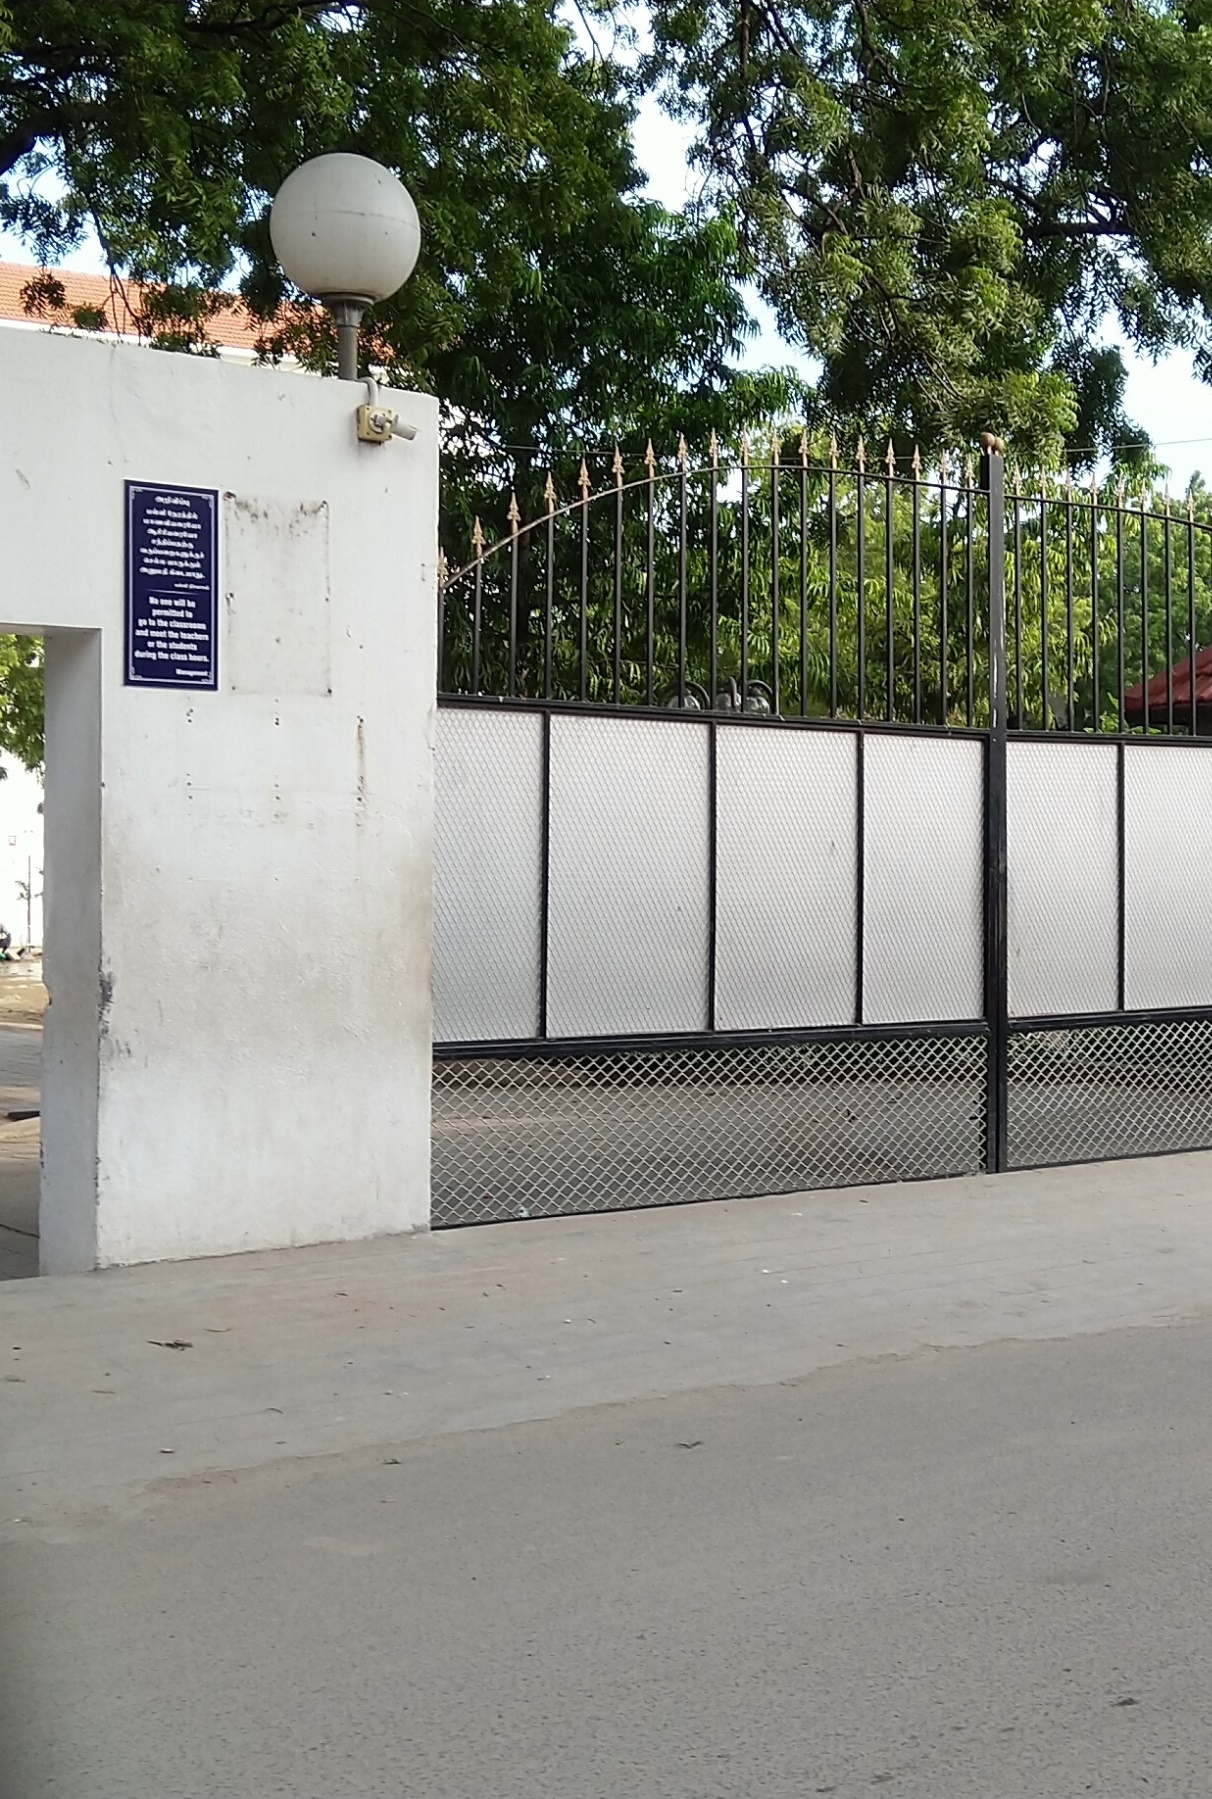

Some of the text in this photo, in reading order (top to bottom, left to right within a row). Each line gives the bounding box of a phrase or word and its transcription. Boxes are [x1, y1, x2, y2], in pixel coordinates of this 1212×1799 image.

[148, 596, 196, 608] No one will be
[152, 608, 194, 618] permitted to
[138, 618, 207, 630] go to the classrooms
[135, 628, 209, 641] and meet the teachers
[156, 640, 167, 649] the
[168, 641, 198, 651] students
[134, 649, 157, 660] during
[157, 651, 169, 660] the
[170, 652, 188, 661] class
